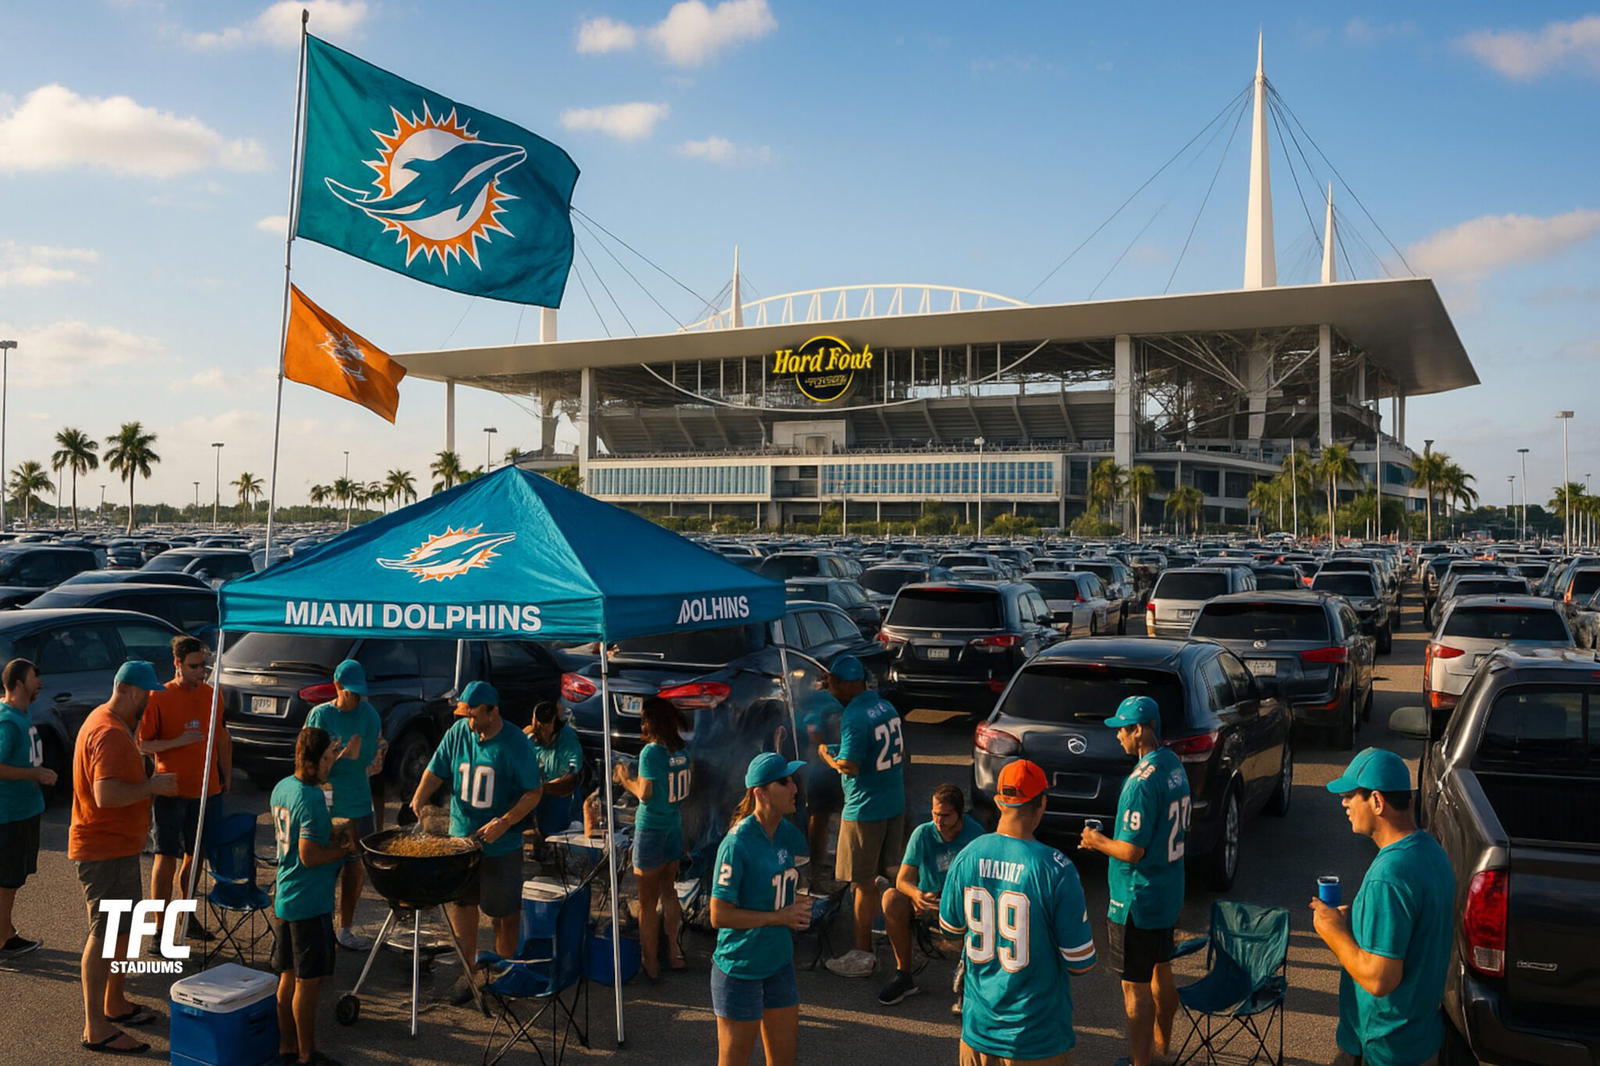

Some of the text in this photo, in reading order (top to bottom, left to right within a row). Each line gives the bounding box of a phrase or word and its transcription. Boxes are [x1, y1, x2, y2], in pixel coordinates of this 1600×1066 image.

[772, 347, 825, 374] Hard
[284, 601, 543, 632] MIAMI DOLPHINS
[874, 716, 904, 771] 23
[458, 762, 496, 809] 10
[717, 863, 733, 887] 2
[963, 885, 1031, 973] 99
